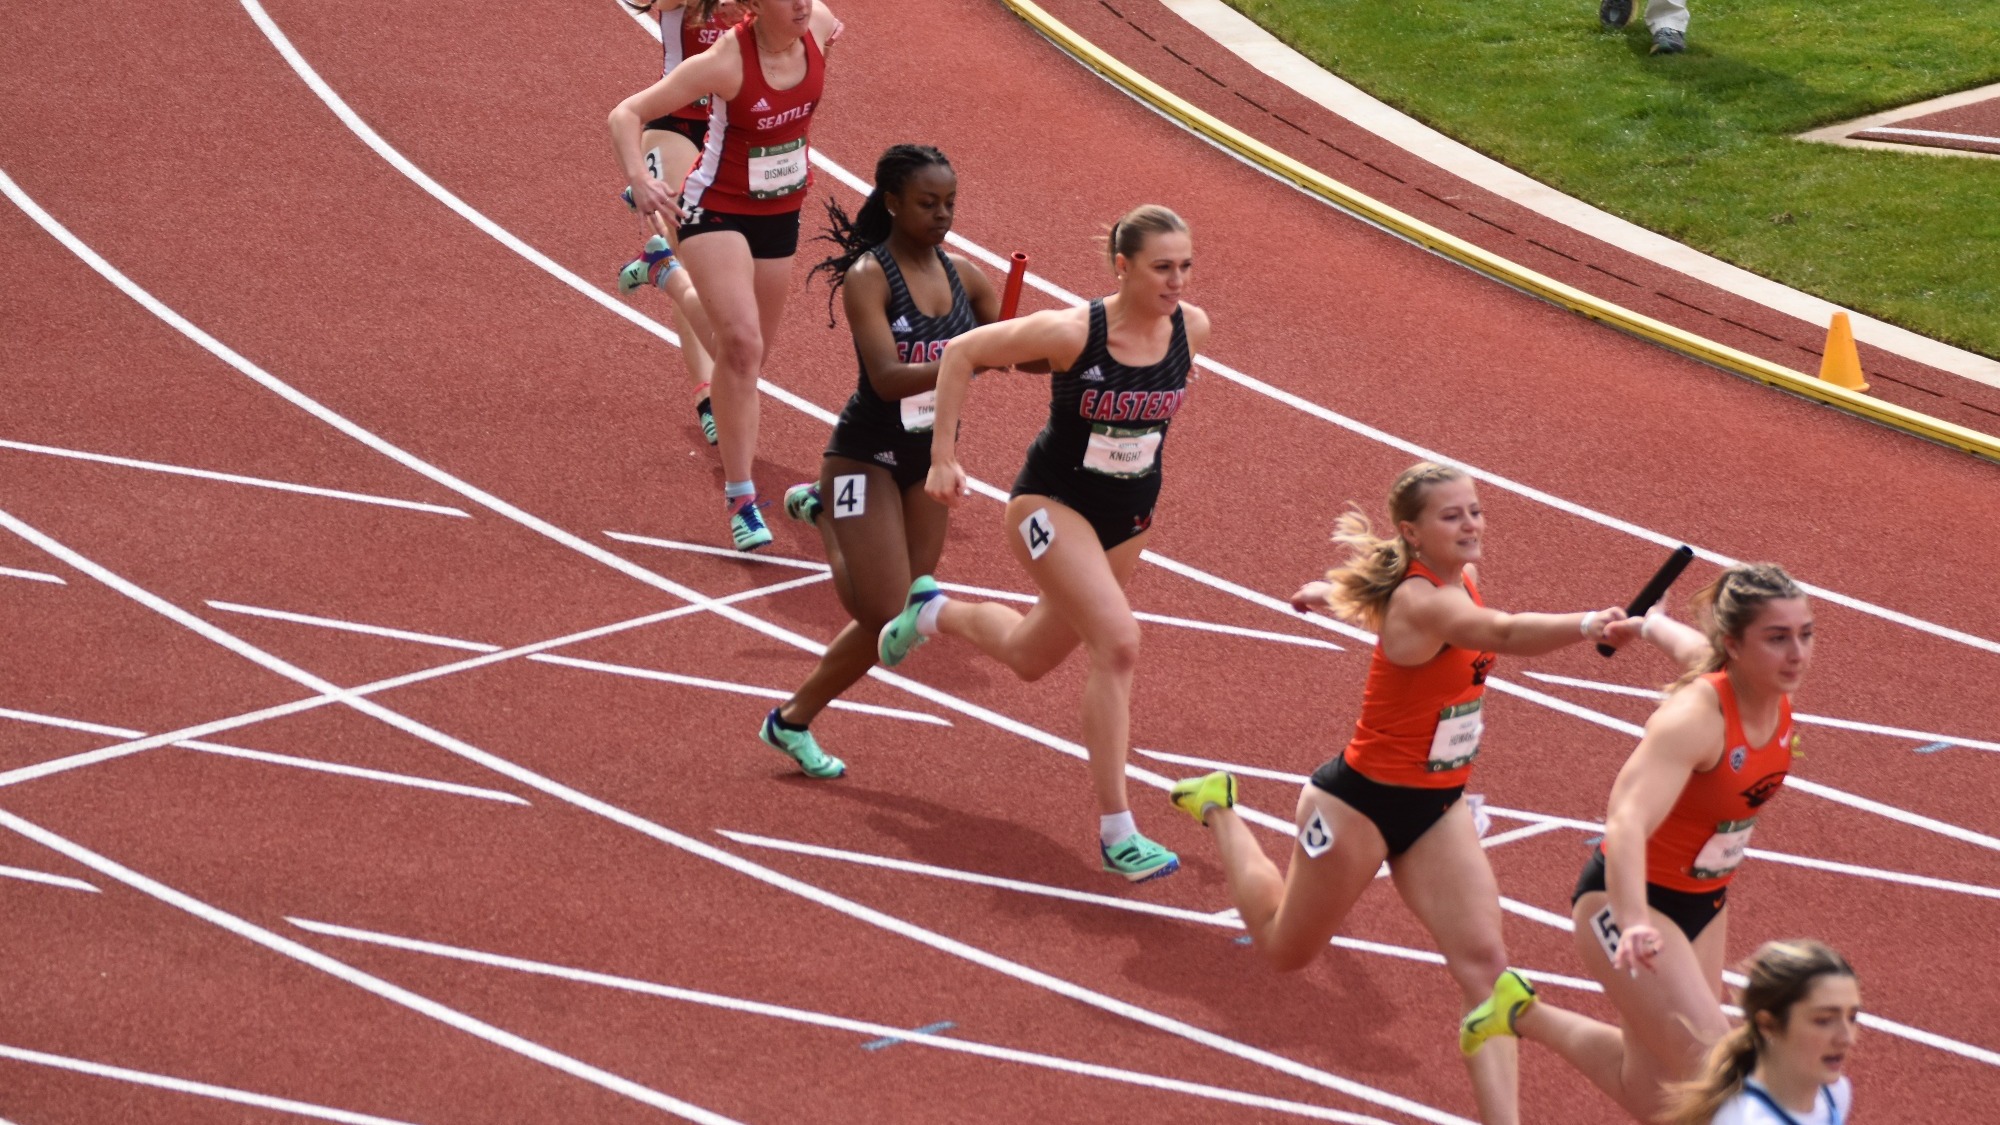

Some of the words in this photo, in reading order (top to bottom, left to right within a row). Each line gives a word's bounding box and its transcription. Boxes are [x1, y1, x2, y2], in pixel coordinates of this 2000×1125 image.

[757, 102, 812, 130] SEATTLE
[646, 152, 659, 179] 3
[764, 163, 799, 180] DISMUKES
[1109, 451, 1142, 461] KNIGHT
[836, 478, 858, 513] 4
[1029, 516, 1051, 551] 4
[1597, 909, 1620, 952] 5
